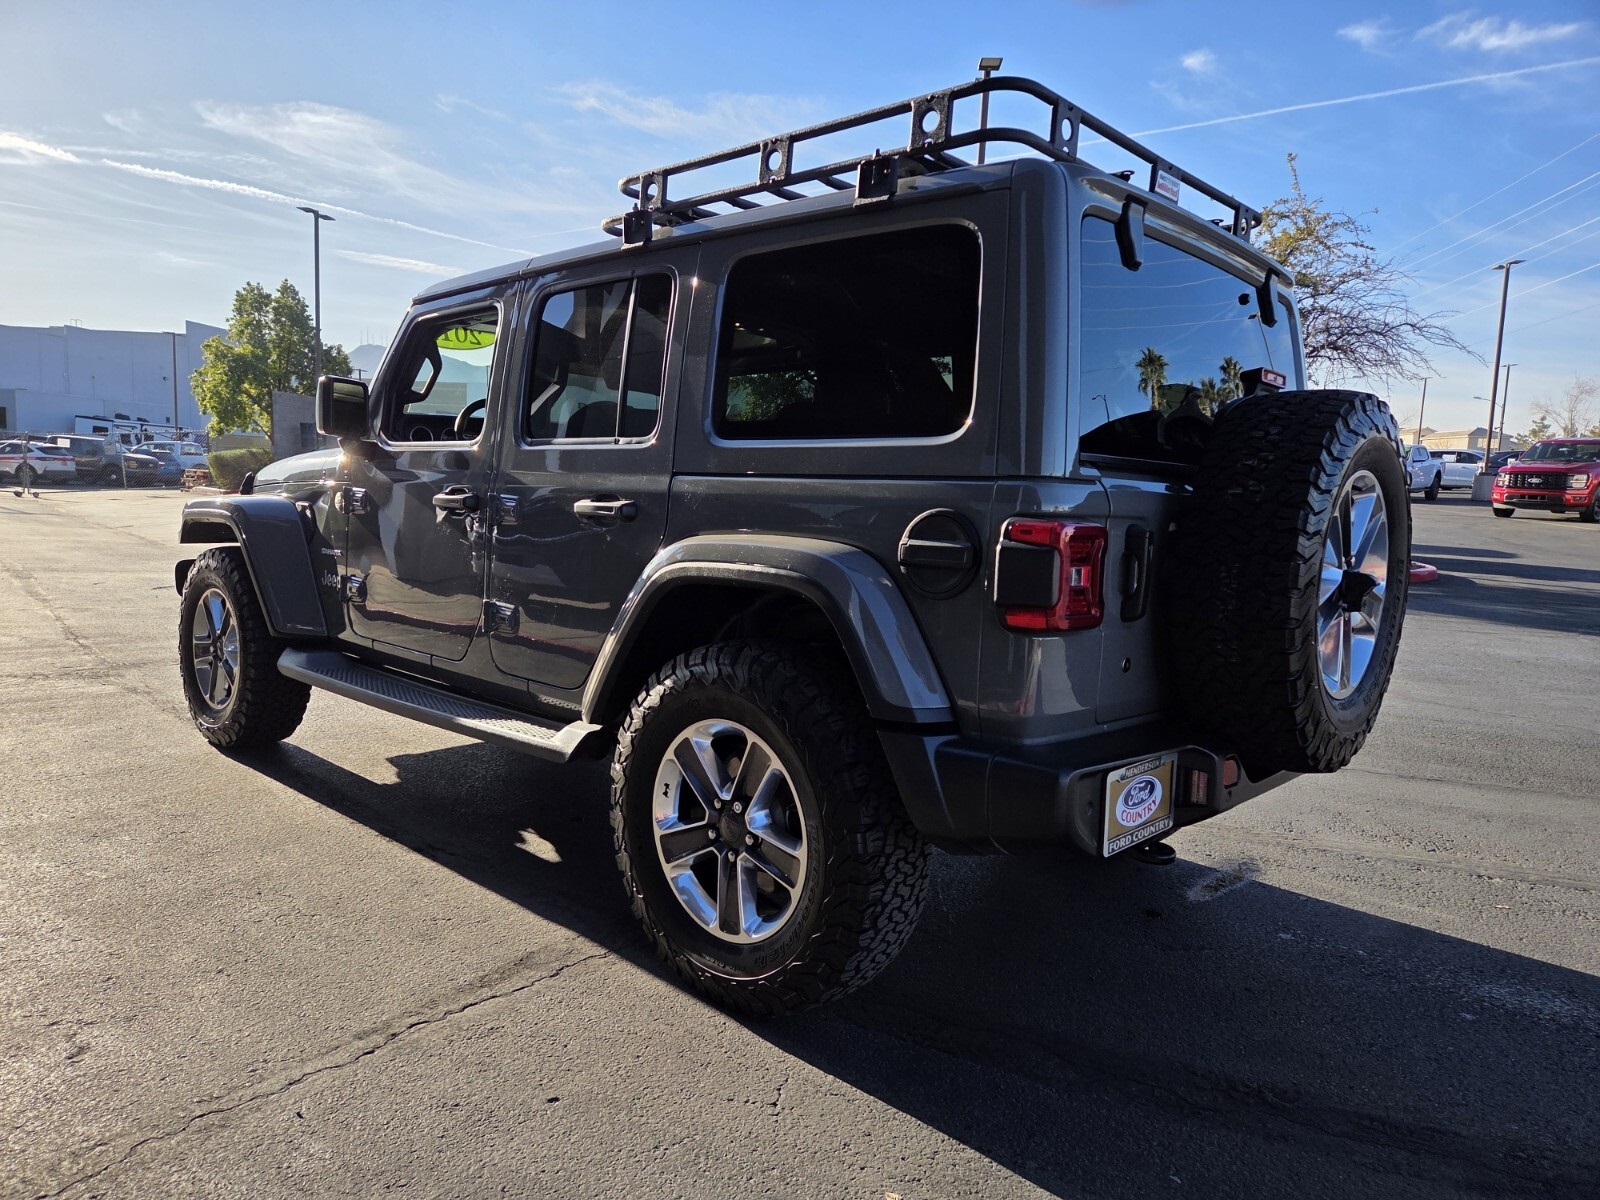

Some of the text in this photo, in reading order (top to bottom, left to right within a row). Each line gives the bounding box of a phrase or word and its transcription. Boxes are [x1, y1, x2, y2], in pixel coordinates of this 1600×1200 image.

[321, 569, 342, 591] Jeep
[1125, 760, 1160, 778] HENDERSON
[1128, 782, 1151, 806] Ford
[1121, 796, 1157, 823] COUNTRY
[1109, 819, 1170, 853] FORD COUNTRY
